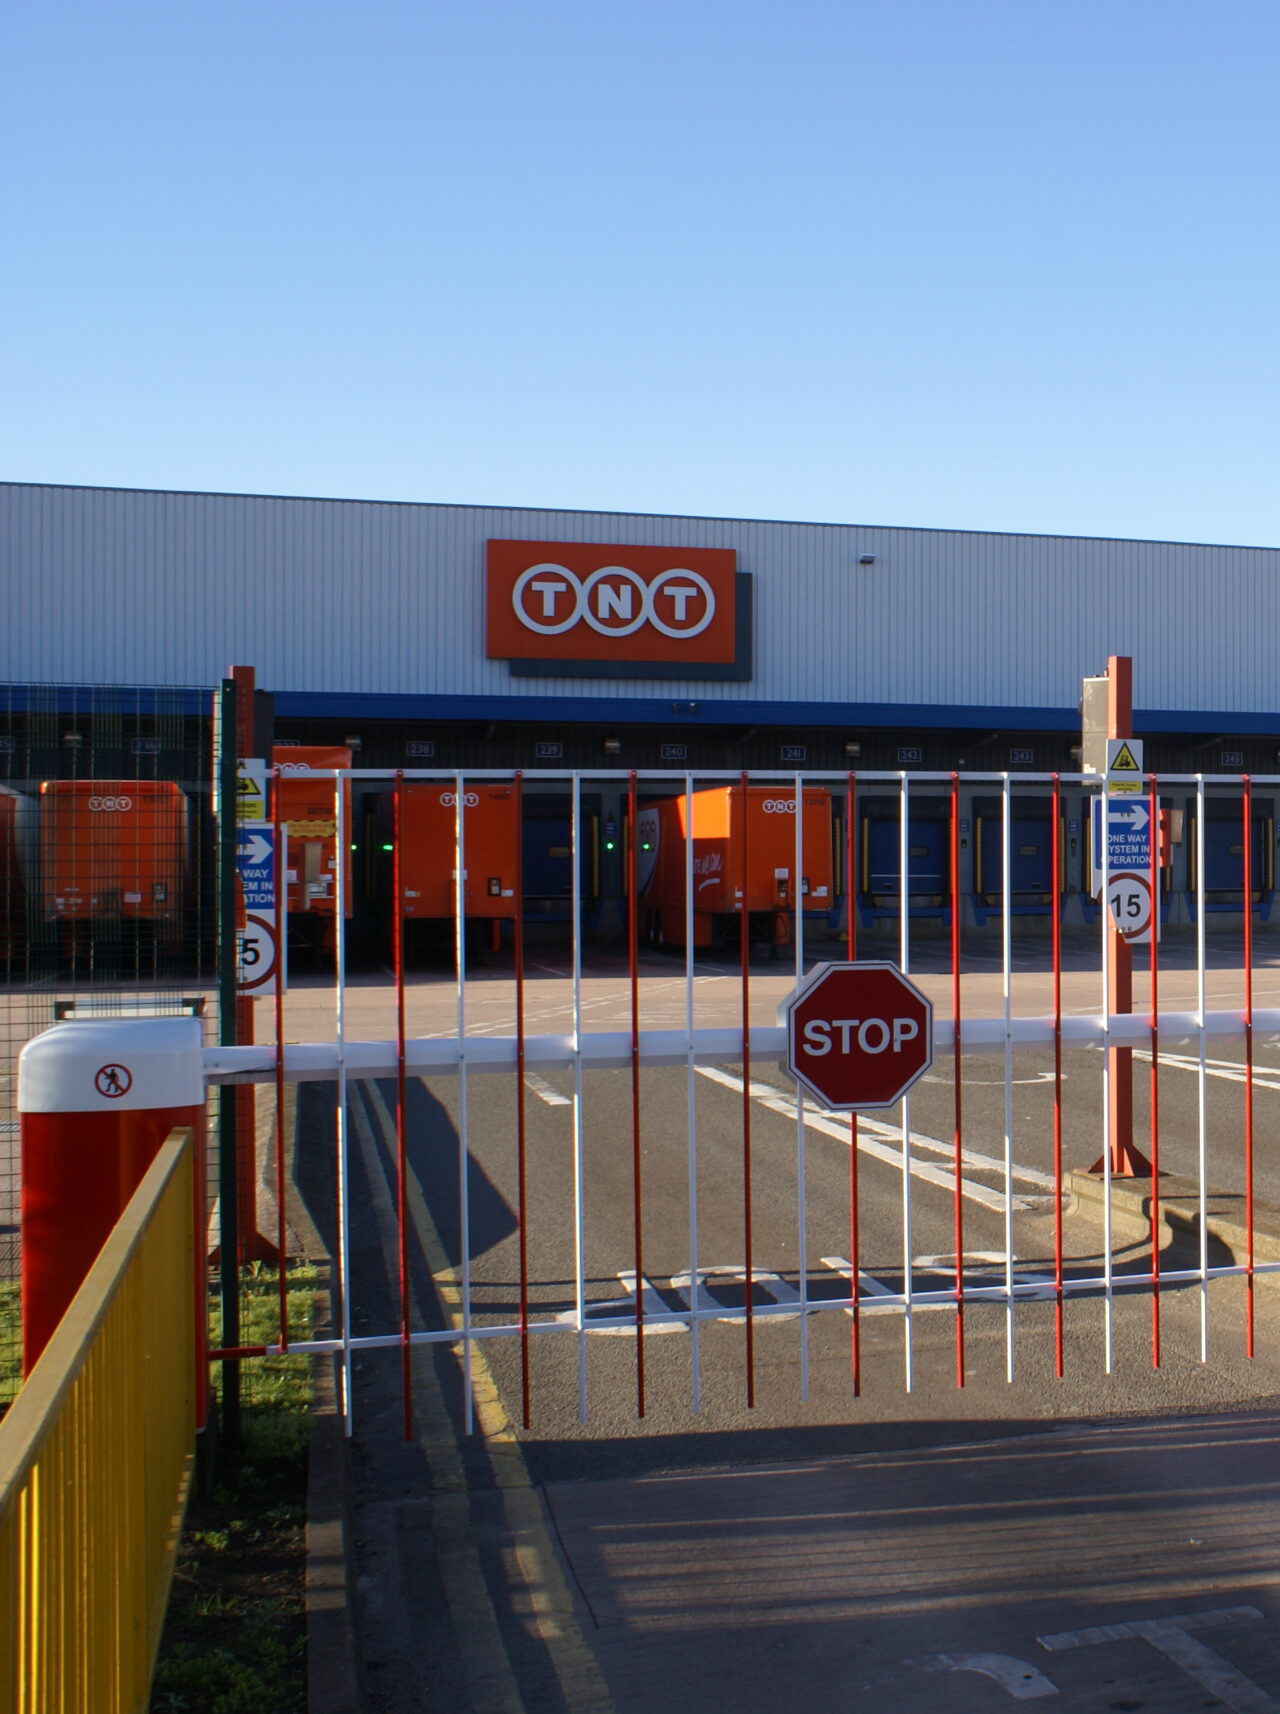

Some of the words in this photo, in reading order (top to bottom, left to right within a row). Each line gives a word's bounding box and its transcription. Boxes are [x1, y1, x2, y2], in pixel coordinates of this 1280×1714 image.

[410, 743, 430, 754] 238
[539, 743, 559, 754] 239
[664, 746, 683, 757] 240
[785, 748, 801, 759] 241
[901, 749, 920, 760] 242
[1012, 751, 1029, 761] 243
[1223, 754, 1240, 764] 245
[1127, 834, 1147, 843] WAY
[1109, 845, 1139, 854] YSTEM
[1141, 845, 1150, 854] IN
[1101, 856, 1152, 864] PERATION
[243, 869, 268, 878] WAY
[261, 881, 273, 890] IN
[1111, 894, 1141, 918] 15
[242, 939, 260, 965] 5
[803, 1017, 919, 1056] STOP
